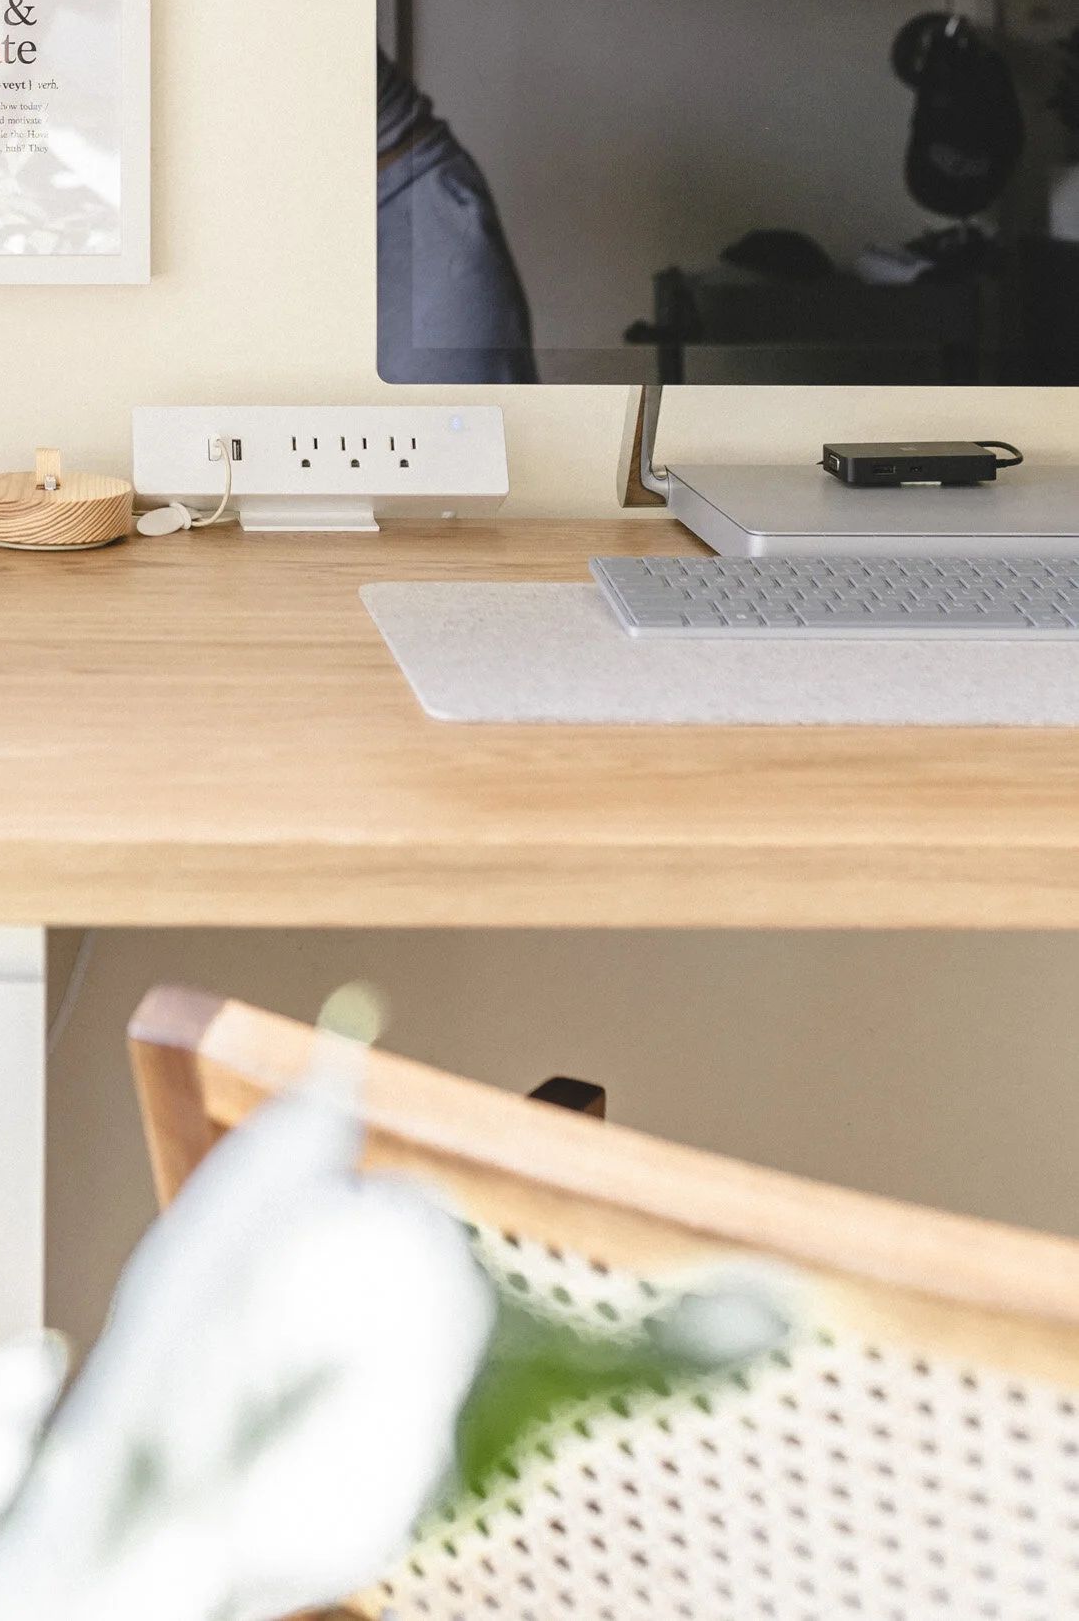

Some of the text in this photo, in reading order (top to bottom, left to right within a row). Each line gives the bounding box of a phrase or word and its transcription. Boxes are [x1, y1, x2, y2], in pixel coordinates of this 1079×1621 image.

[20, 102, 43, 112] today
[7, 116, 43, 125] motivate
[28, 144, 49, 153] They
